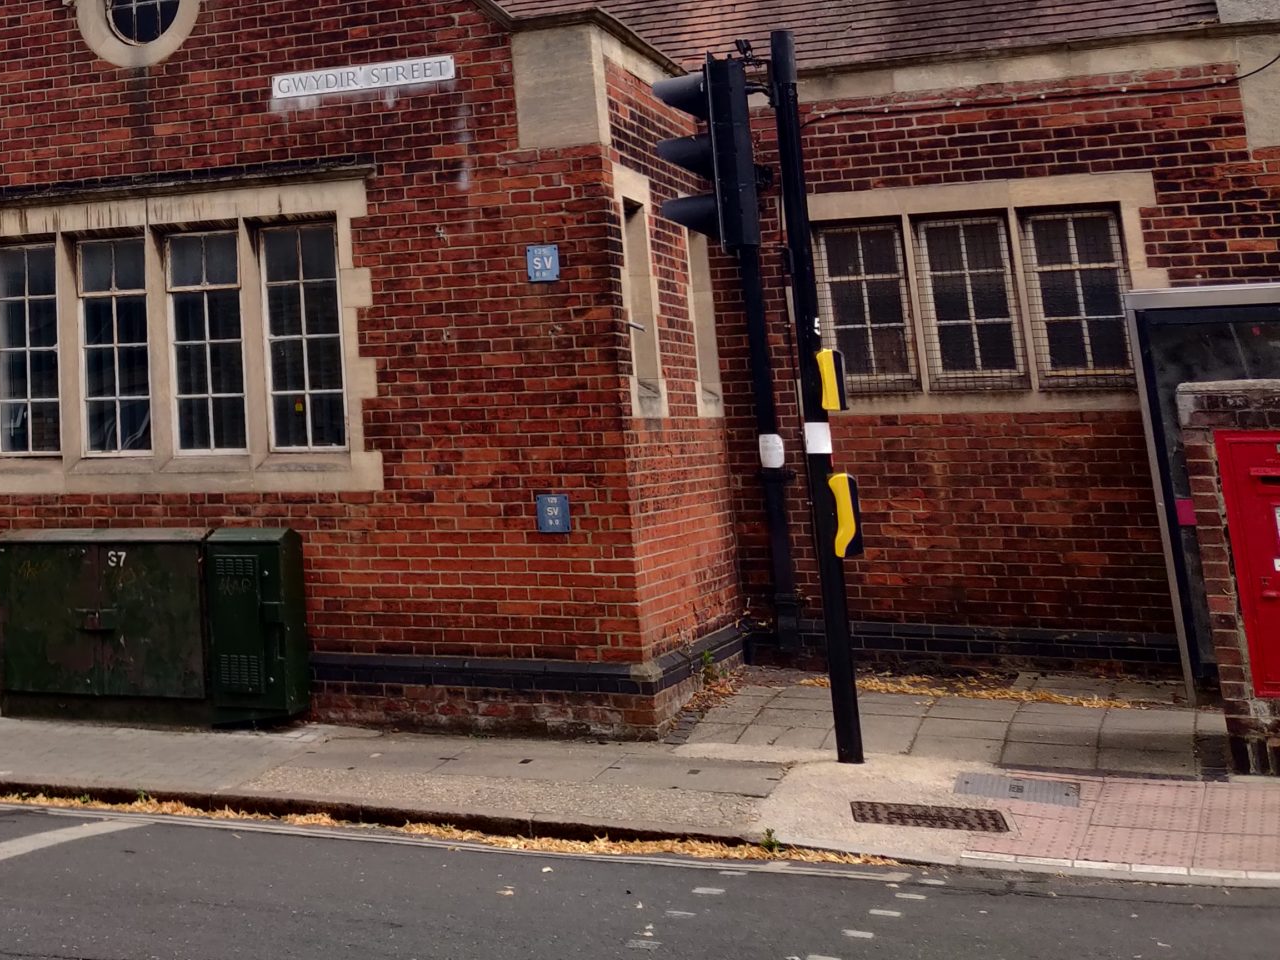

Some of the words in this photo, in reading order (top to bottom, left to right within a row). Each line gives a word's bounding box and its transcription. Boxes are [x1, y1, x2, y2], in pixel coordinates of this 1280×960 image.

[277, 71, 359, 94] GWYDIR
[371, 60, 447, 84] STREET
[533, 256, 553, 270] SV
[546, 506, 559, 516] SV
